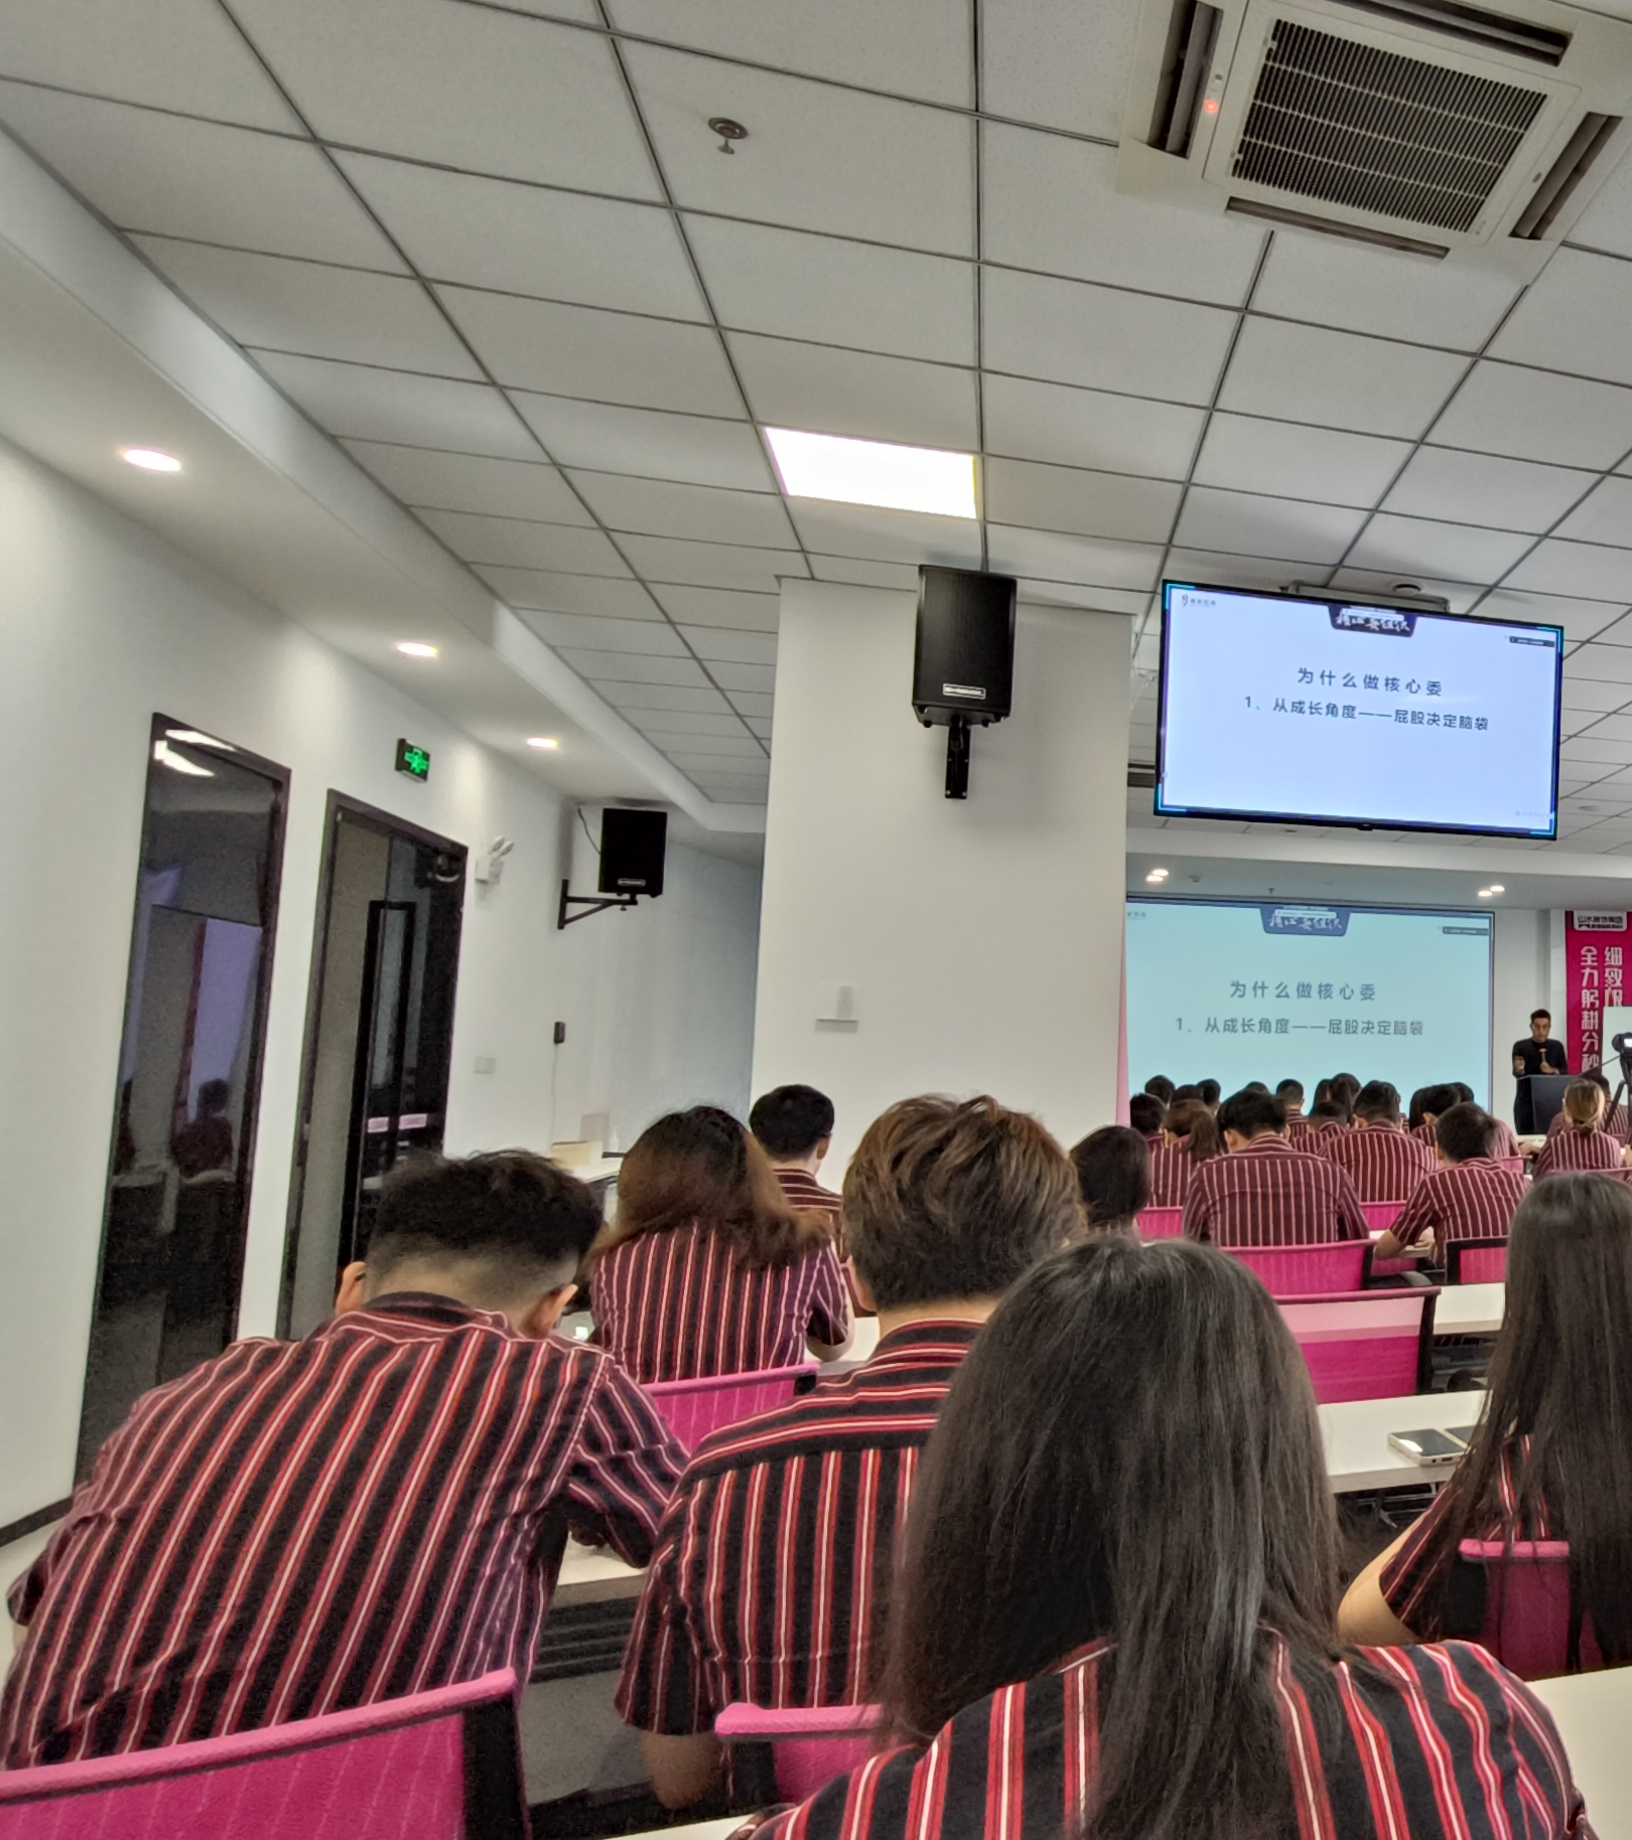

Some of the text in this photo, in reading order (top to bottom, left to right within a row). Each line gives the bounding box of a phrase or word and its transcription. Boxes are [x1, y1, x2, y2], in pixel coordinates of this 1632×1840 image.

[1297, 667, 1443, 697] 为什么做核心委
[1229, 980, 1377, 1002] 为什么做核心委
